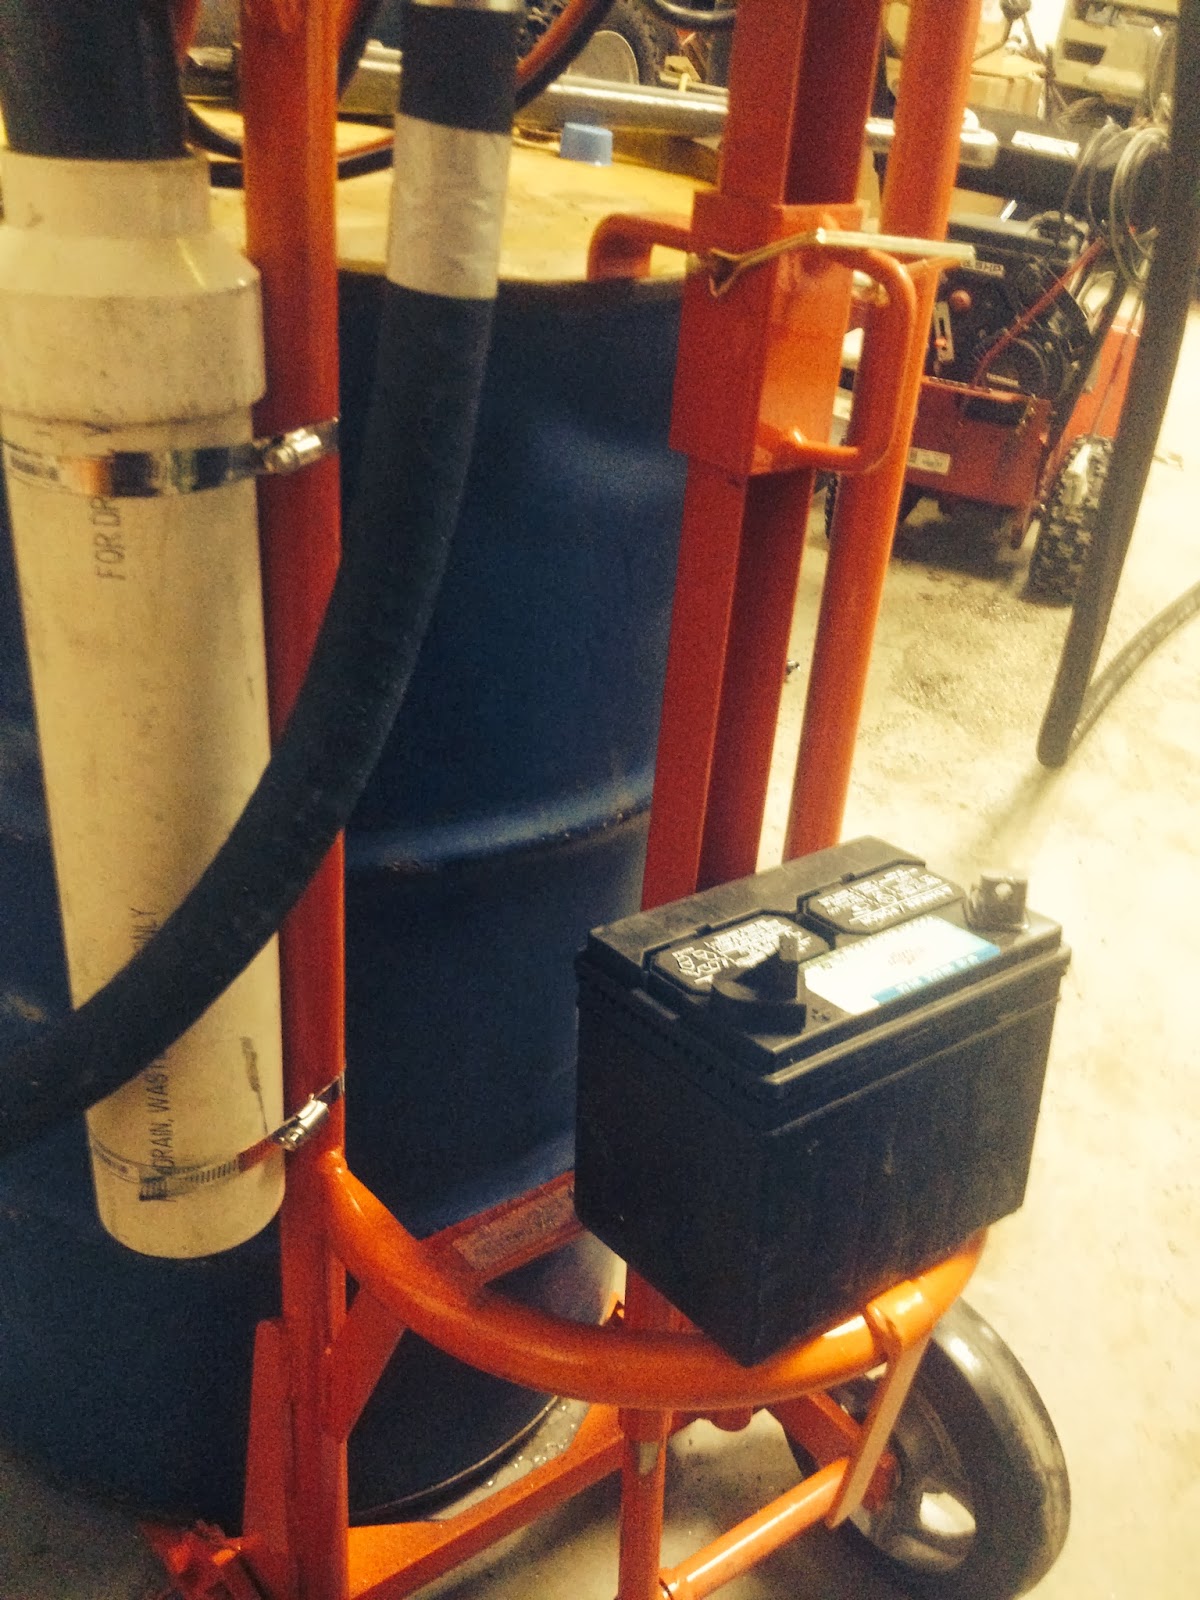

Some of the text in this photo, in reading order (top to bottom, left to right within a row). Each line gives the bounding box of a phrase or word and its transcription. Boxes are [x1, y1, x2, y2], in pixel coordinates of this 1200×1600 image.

[95, 532, 126, 581] FOR
[129, 907, 157, 950] NLY
[146, 1059, 170, 1112] WAST
